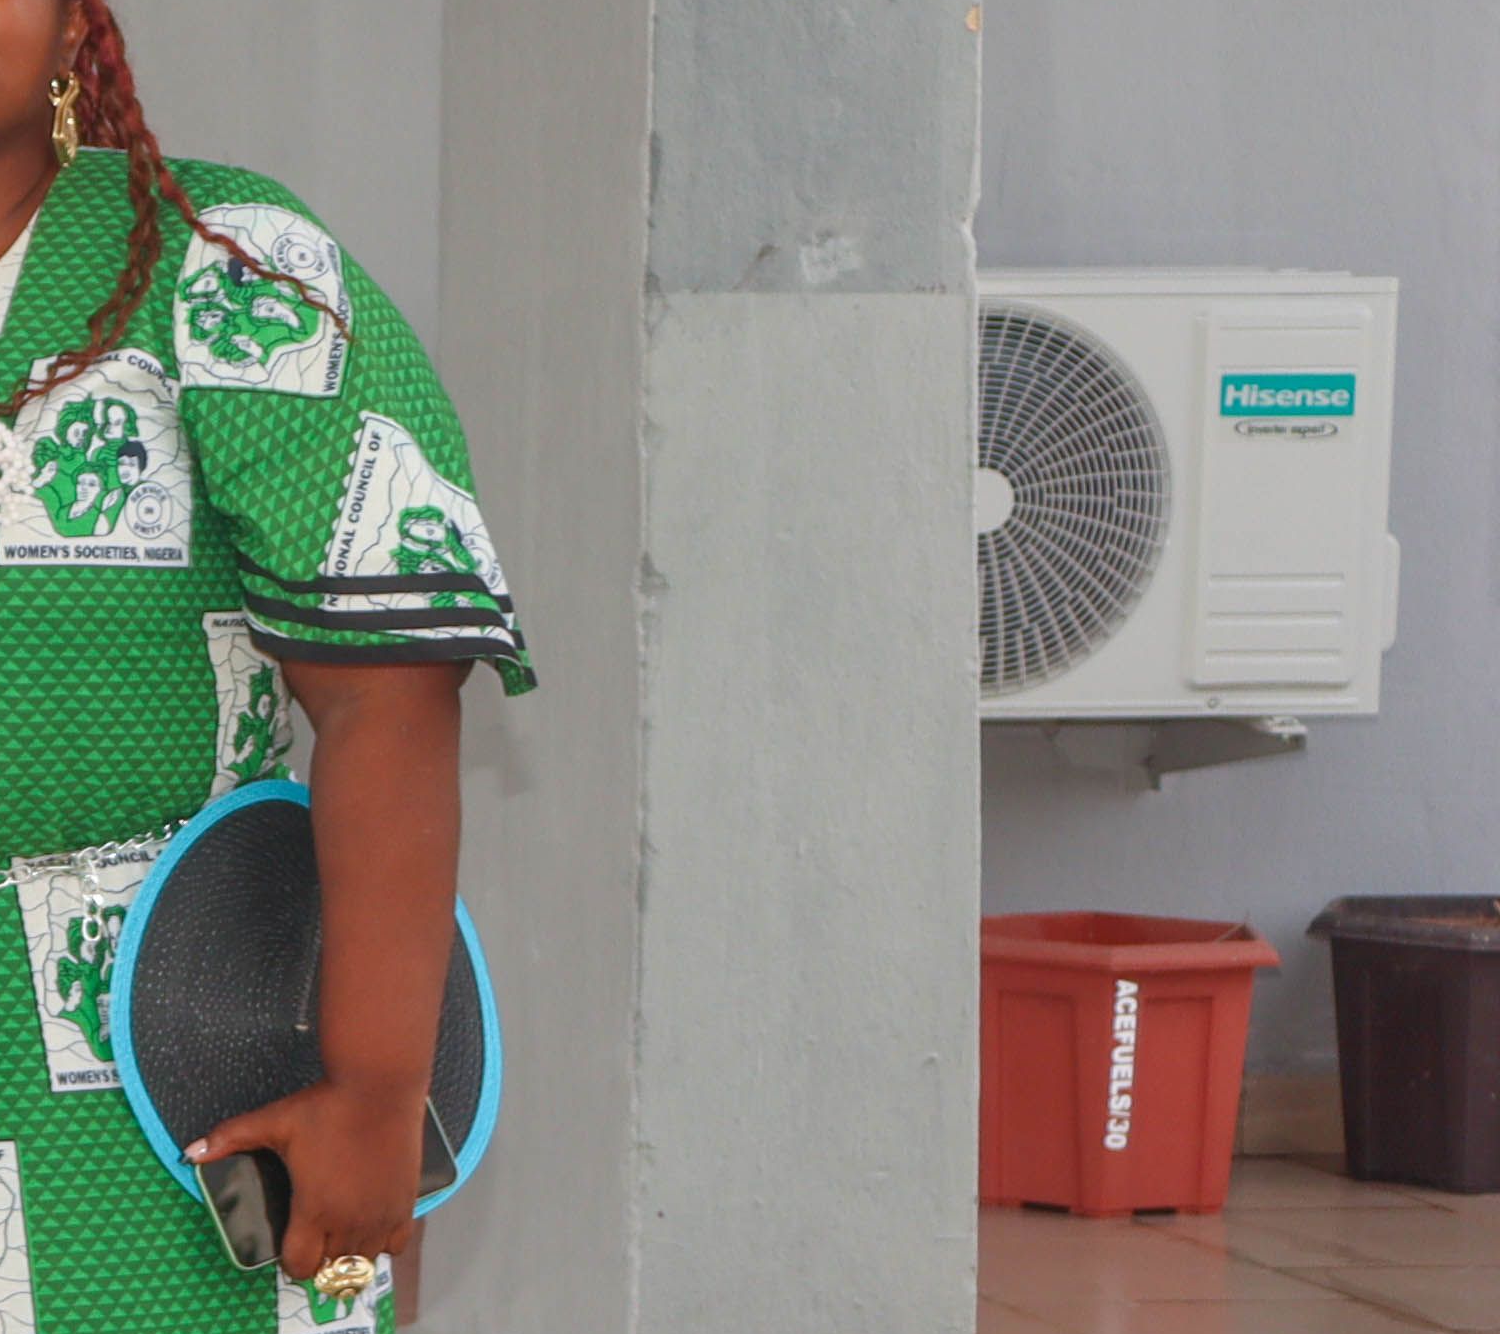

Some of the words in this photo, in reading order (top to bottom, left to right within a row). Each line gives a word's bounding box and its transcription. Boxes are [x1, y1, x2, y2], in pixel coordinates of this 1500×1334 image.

[324, 331, 343, 392] WOMEN'S
[1225, 384, 1349, 407] Hisense
[349, 457, 377, 523] COUNCIL
[369, 431, 382, 451] OF
[5, 545, 70, 559] WOMEN'S
[74, 546, 140, 561] SOCIETIES,
[144, 547, 183, 561] NIGERIA
[56, 1068, 109, 1085] WOMEN'S
[1104, 979, 1139, 1150] ACEFUELS/30
